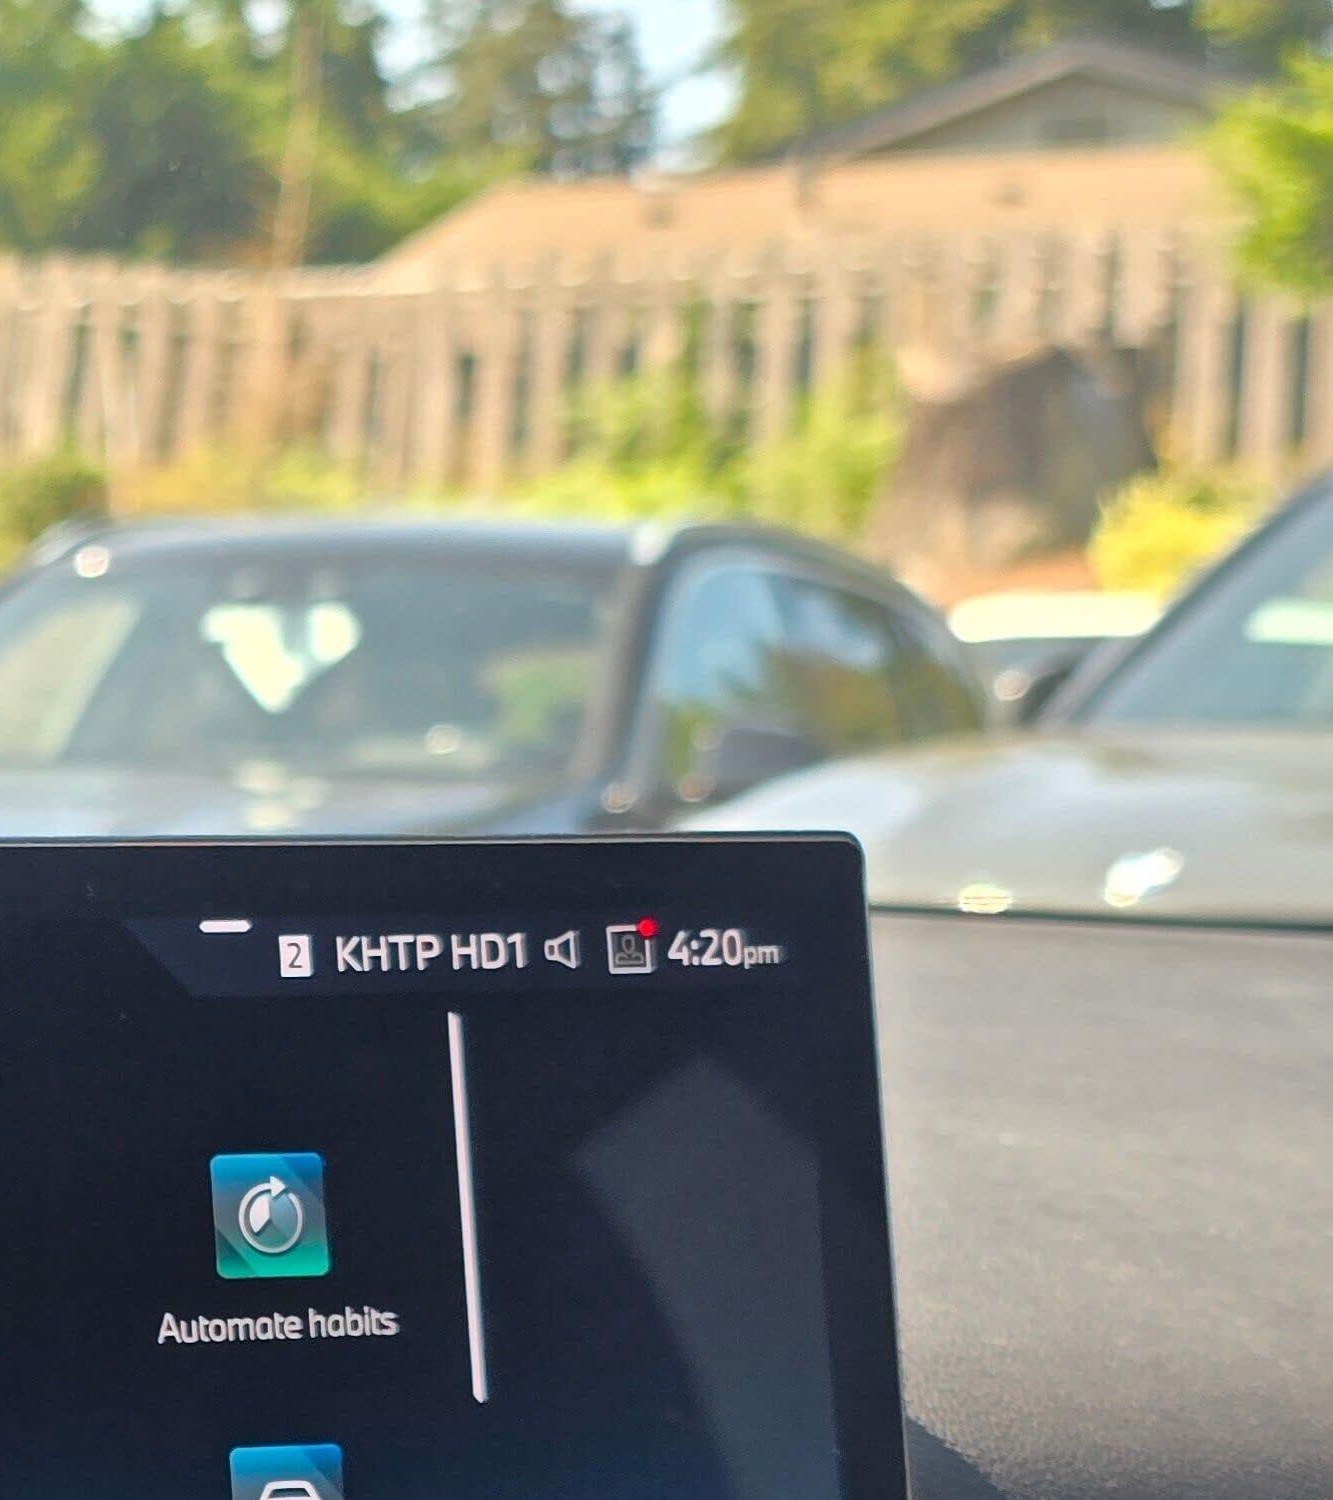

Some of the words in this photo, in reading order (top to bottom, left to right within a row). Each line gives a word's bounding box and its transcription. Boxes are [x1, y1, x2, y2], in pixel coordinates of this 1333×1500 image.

[335, 934, 442, 972] KHTP
[450, 932, 525, 970] HD1
[157, 1312, 304, 1345] Automate
[308, 1305, 399, 1339] habits
